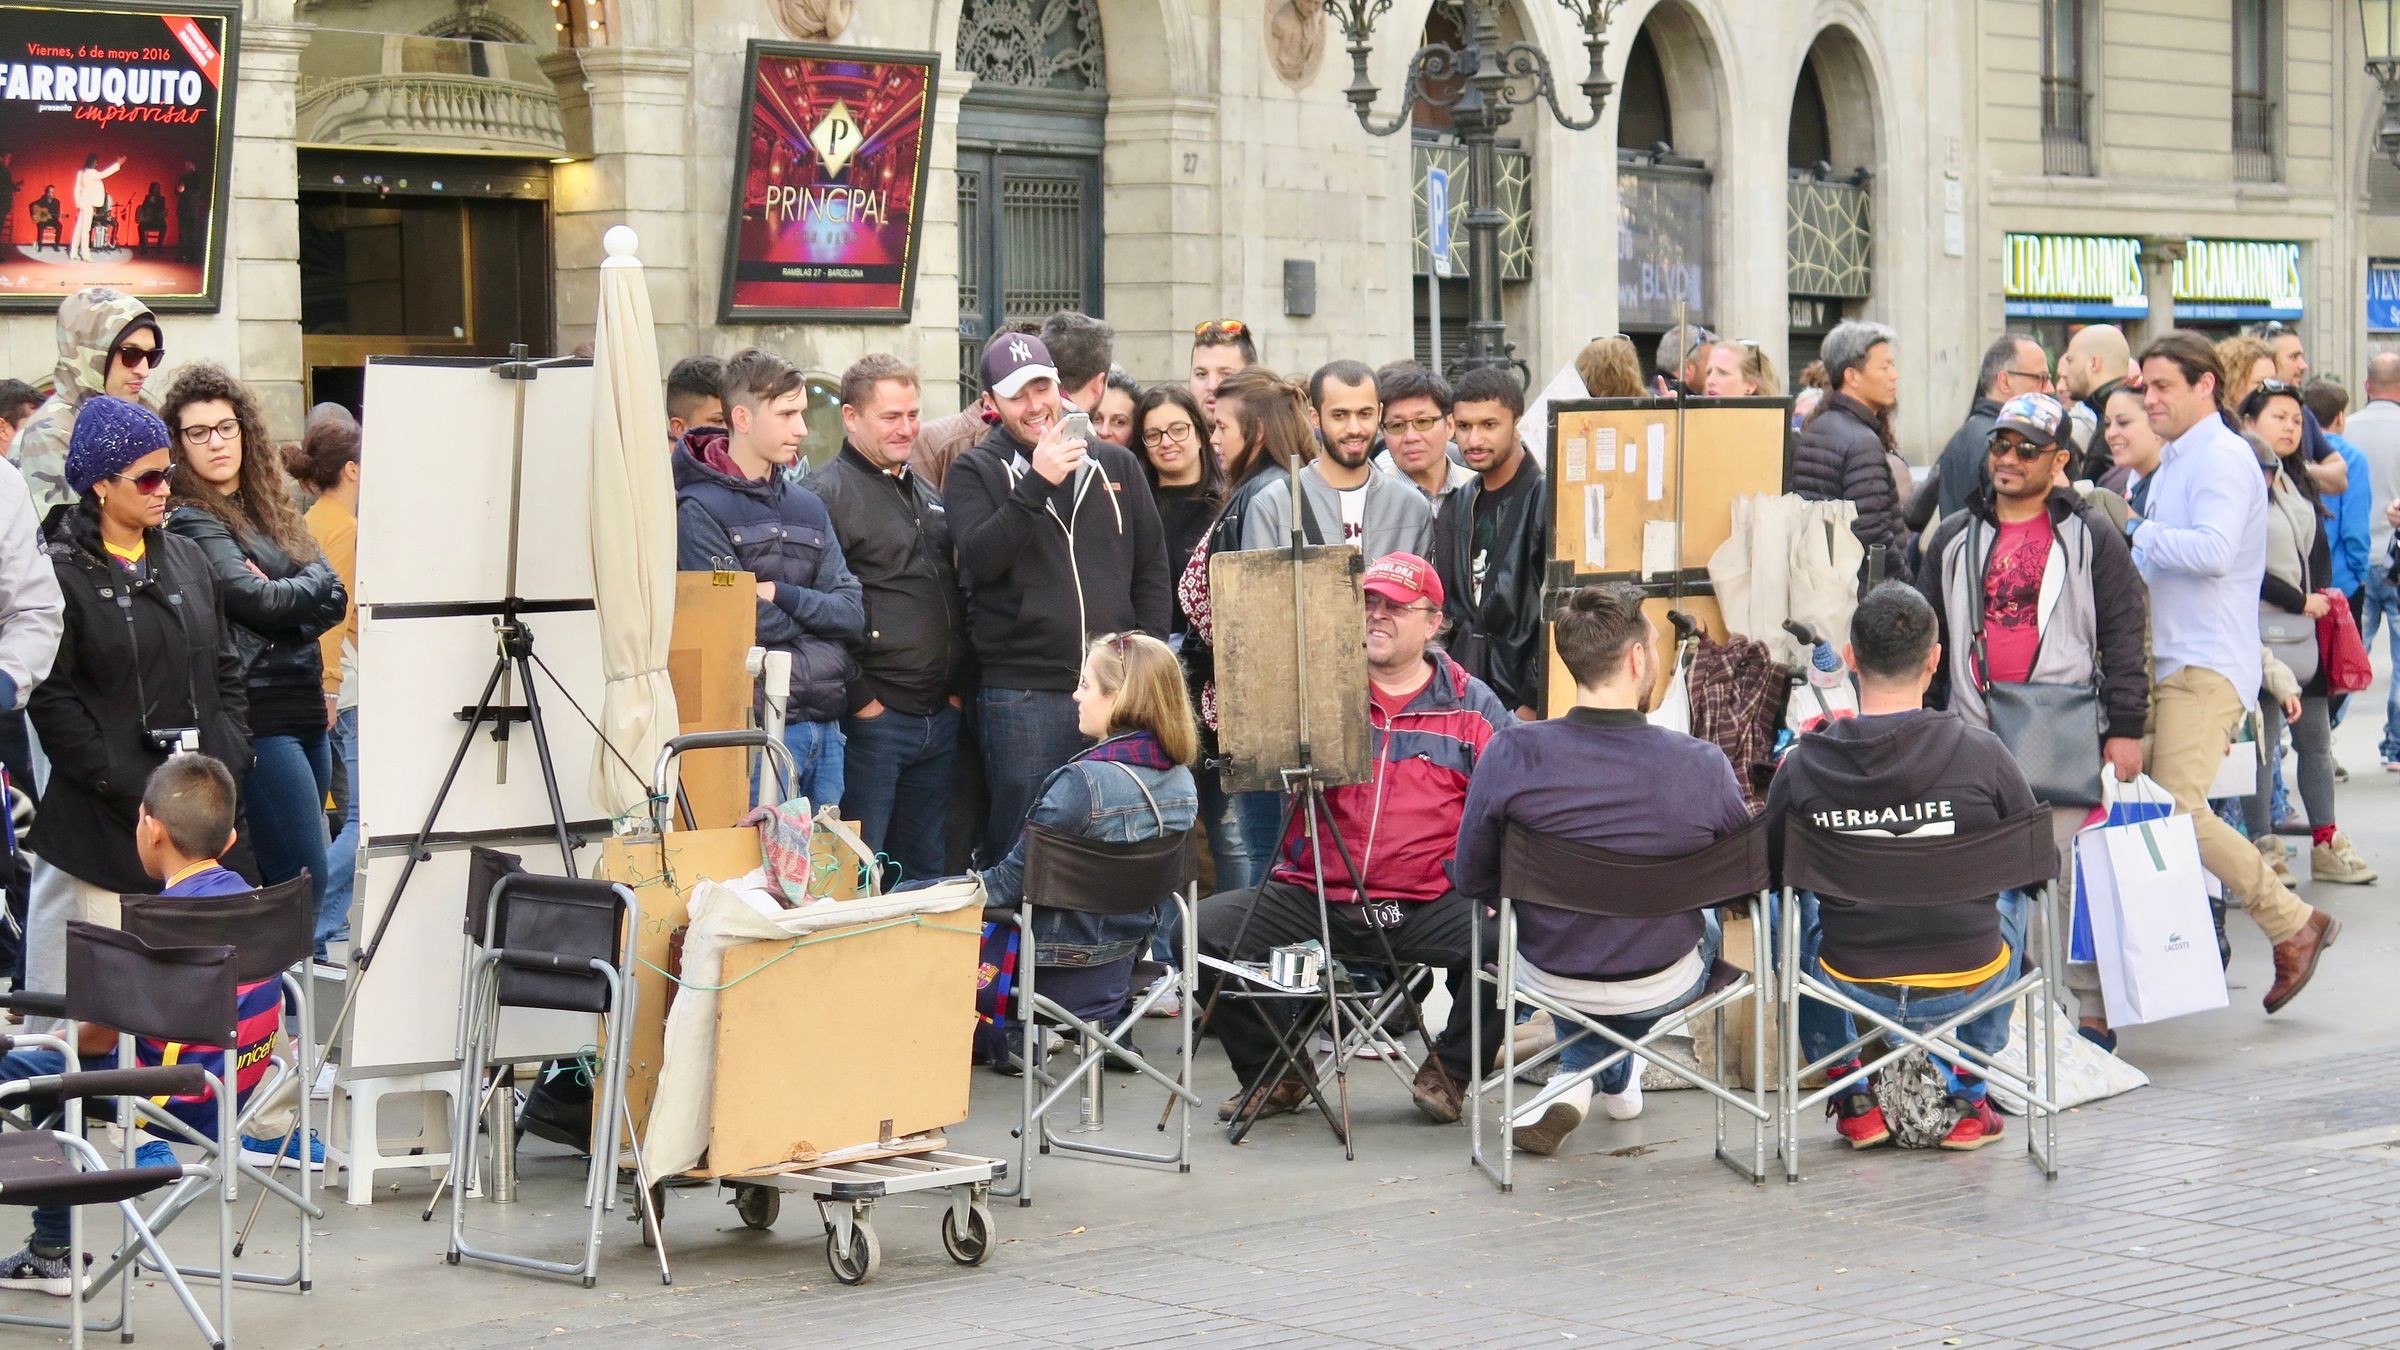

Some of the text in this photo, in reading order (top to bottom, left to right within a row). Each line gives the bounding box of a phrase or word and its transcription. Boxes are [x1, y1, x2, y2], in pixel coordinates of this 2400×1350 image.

[28, 43, 171, 62] Viernes, 6 de mayo 2016
[828, 118, 849, 156] P
[1183, 153, 1198, 174] 27
[765, 185, 889, 225] PRINCIPAL
[1433, 178, 1444, 247] P
[782, 267, 812, 277] RAMBLAS
[827, 268, 864, 278] BARCELONA
[1642, 262, 1688, 300] BLVD
[1813, 800, 1954, 828] HERBALIFE
[2164, 941, 2190, 952] LACOSTE
